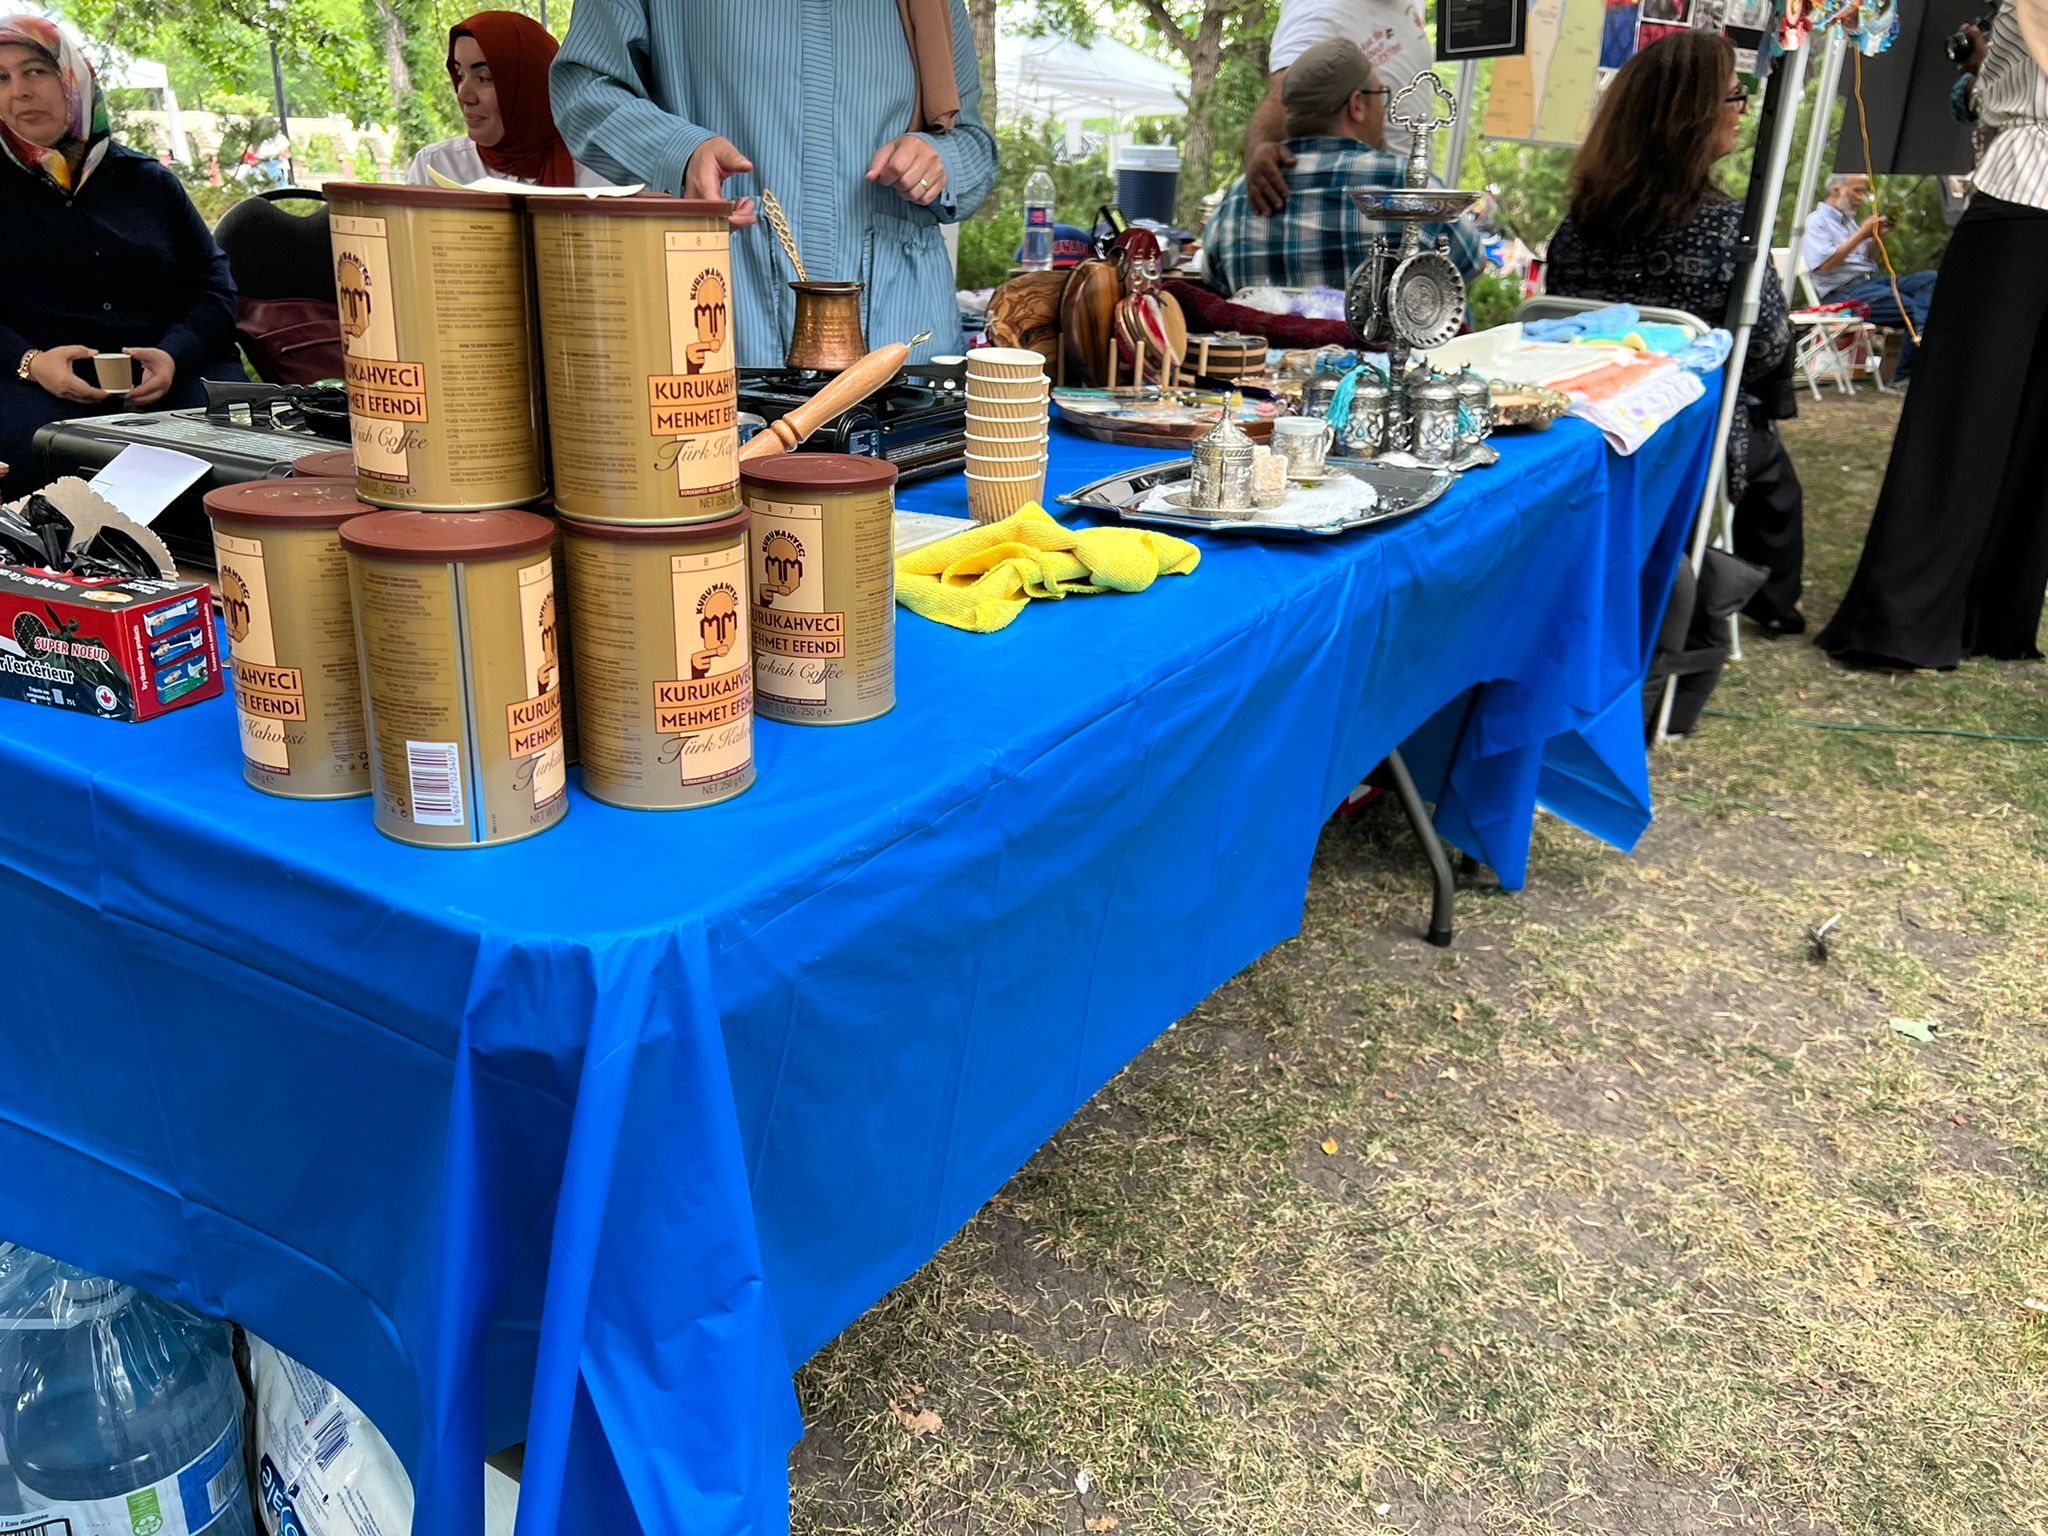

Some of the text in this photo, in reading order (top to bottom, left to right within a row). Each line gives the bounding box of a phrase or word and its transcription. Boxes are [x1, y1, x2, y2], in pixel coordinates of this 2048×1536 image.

[349, 363, 419, 387] KAHVECİ
[655, 375, 735, 400] KURUKAHV
[368, 395, 422, 416] EFENDİ
[657, 408, 720, 429] MEHMET
[377, 426, 429, 455] Coffee
[653, 439, 712, 472] Türk
[700, 497, 715, 508] NET
[751, 608, 840, 632] URUKAHVECİ
[34, 637, 109, 661] SUPER NOEUD
[792, 638, 840, 654] EFENDİ
[5, 655, 74, 684] l'extérieur
[236, 664, 297, 690] KAHVECİ
[799, 662, 845, 685] Coffee
[660, 668, 750, 703] KURUKAHVE
[250, 695, 300, 715] EFENDİ
[513, 692, 560, 726] KURUKA
[661, 704, 727, 728] MEHMET
[731, 695, 750, 716] EFEN
[801, 706, 815, 716] 250
[244, 719, 307, 745] Kahvesi
[658, 733, 714, 765] Türk
[702, 784, 718, 796] NET
[5, 1520, 19, 1528] Eau
